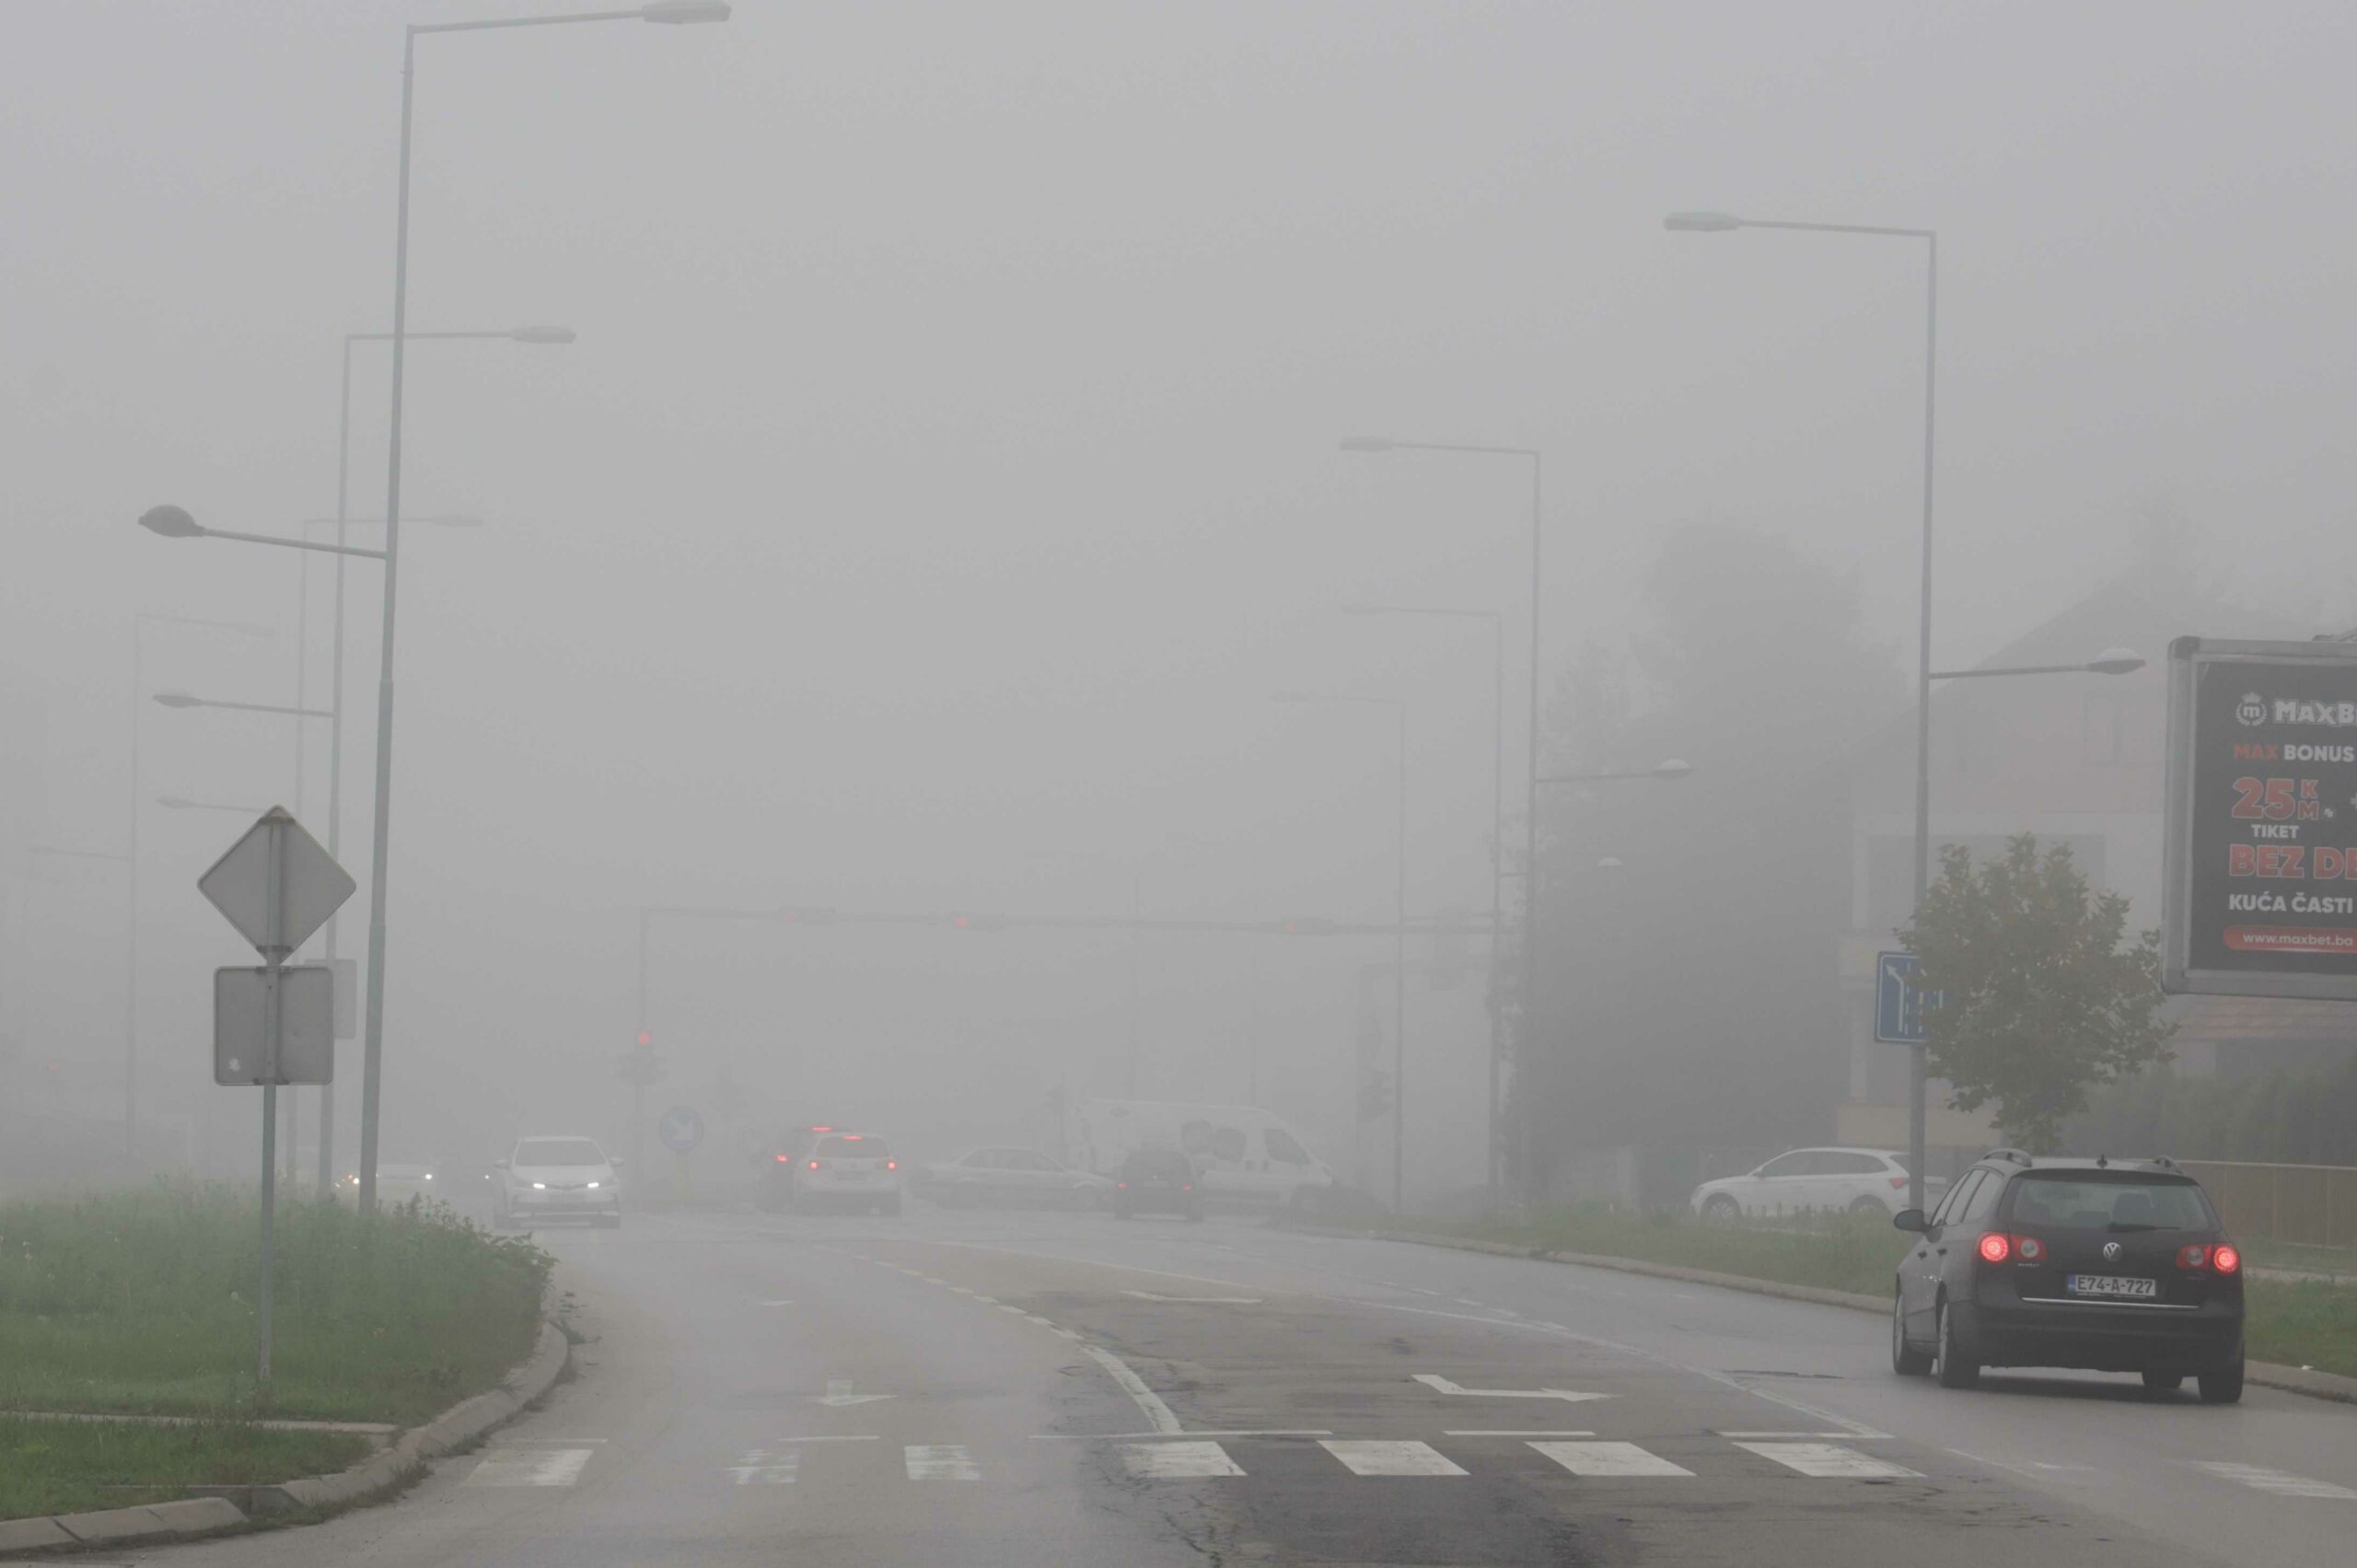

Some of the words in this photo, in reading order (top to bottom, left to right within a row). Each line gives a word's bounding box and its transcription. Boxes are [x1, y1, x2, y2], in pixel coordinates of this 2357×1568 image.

[2273, 699, 2357, 726] MAXB
[2234, 742, 2279, 760] MAX
[2283, 744, 2355, 762] BONUS
[2232, 776, 2296, 820] 25
[2251, 824, 2300, 839] TIKET
[2229, 844, 2305, 878] BEZ
[2228, 891, 2287, 912] KUĆA
[2291, 892, 2353, 914] ČASTI
[2243, 934, 2354, 947] www.maxbet.ba
[2077, 1276, 2154, 1294] E74-A-727
